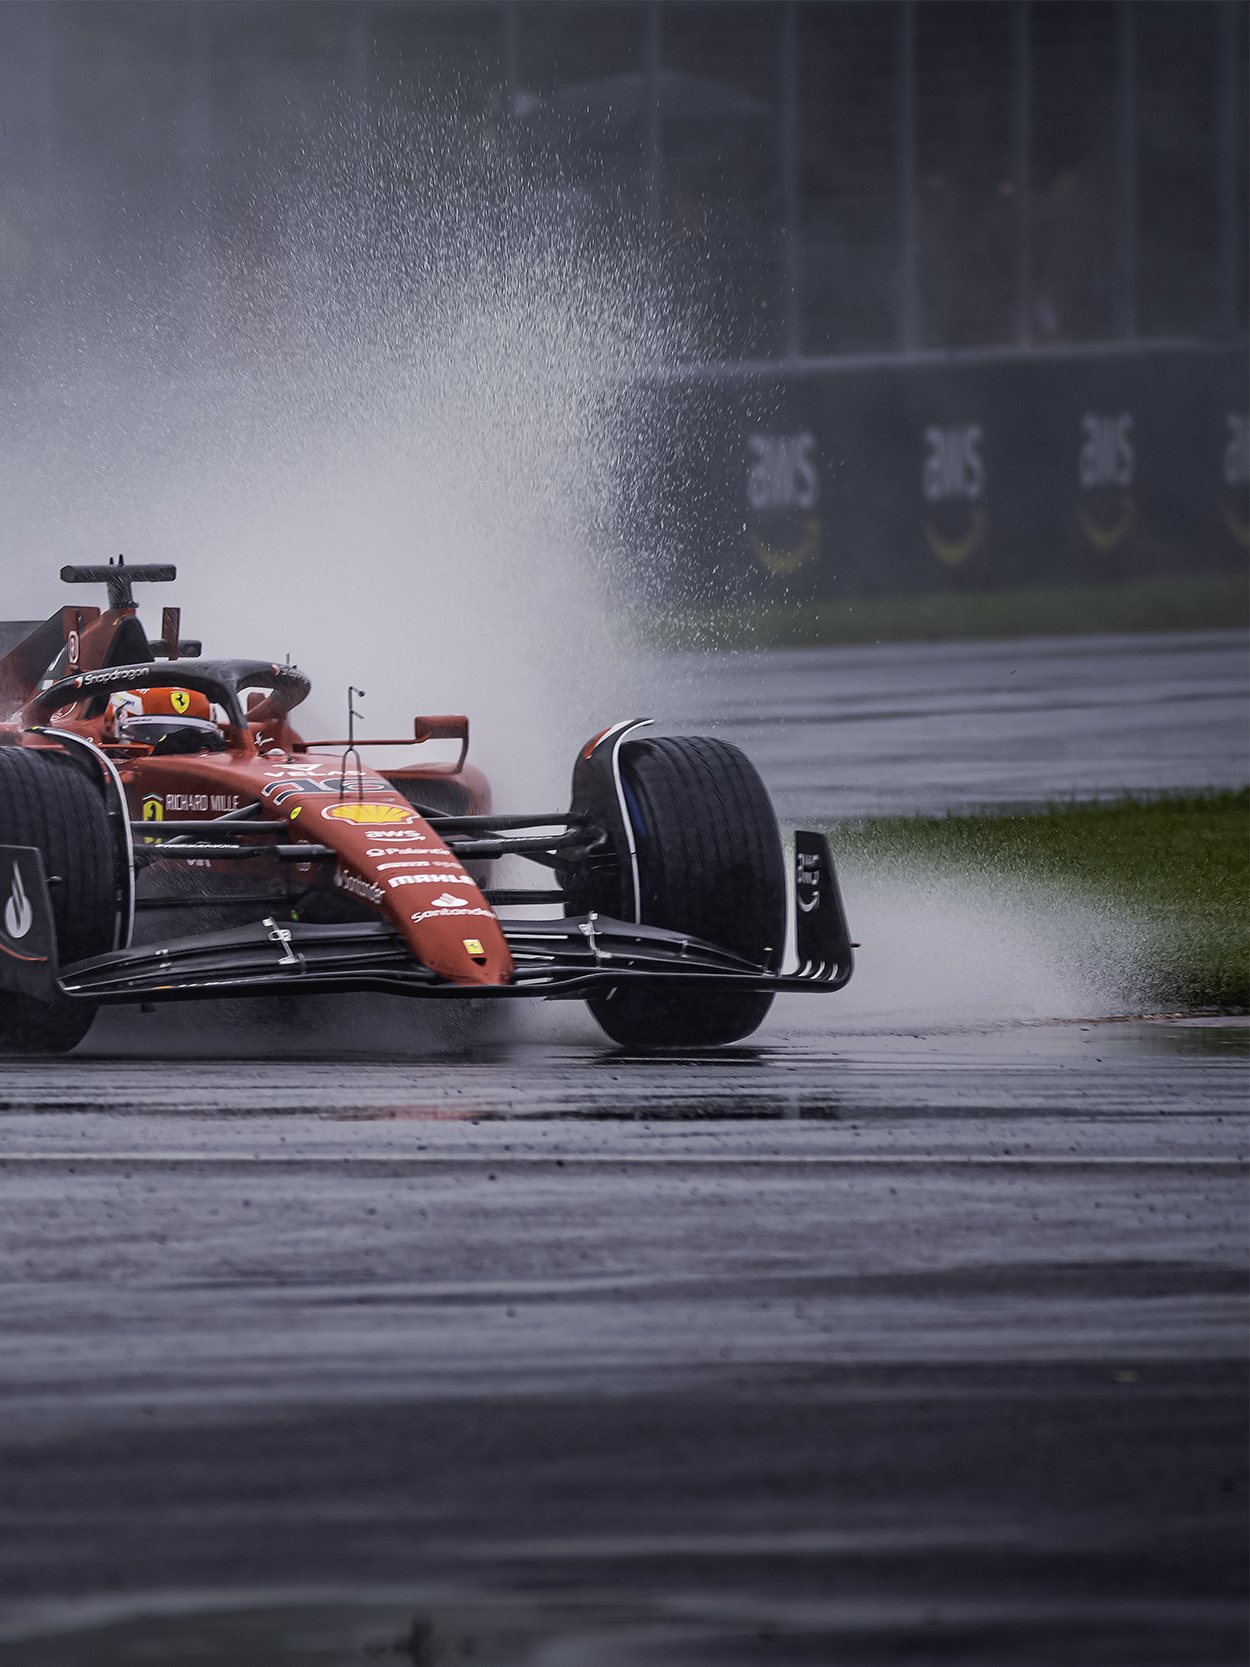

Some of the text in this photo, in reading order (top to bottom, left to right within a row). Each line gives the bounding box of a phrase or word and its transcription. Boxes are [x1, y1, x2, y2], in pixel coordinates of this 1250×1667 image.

[83, 666, 150, 686] Snapdragon
[165, 794, 240, 812] RICHARD MILLE
